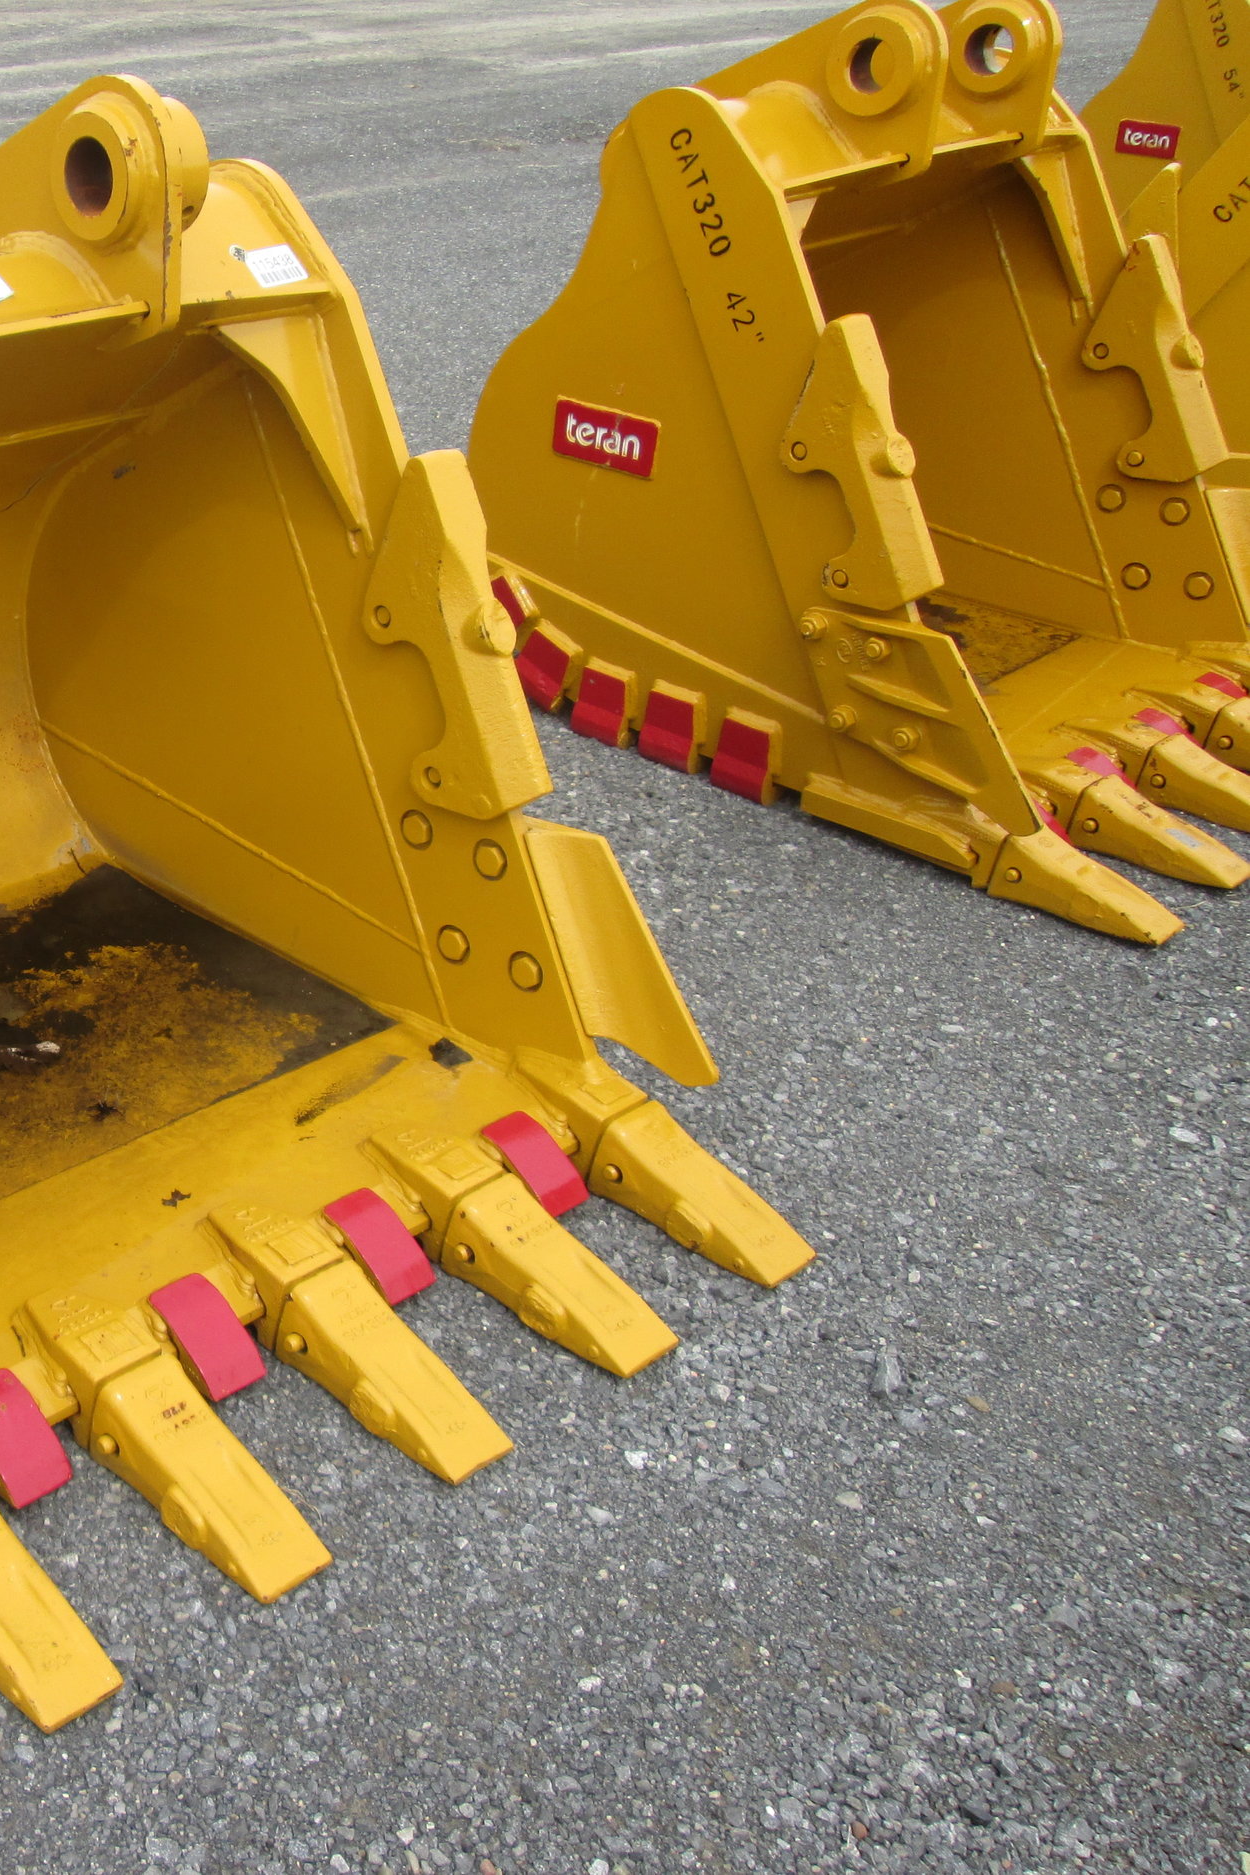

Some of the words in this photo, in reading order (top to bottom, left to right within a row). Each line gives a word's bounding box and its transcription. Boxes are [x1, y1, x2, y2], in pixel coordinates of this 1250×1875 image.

[1205, 0, 1230, 48] T320
[1223, 68, 1245, 99] 54"
[1123, 127, 1170, 150] teran
[670, 128, 731, 257] CAT320
[726, 292, 765, 342] 42"
[252, 253, 294, 272] 115438
[566, 413, 640, 460] teran
